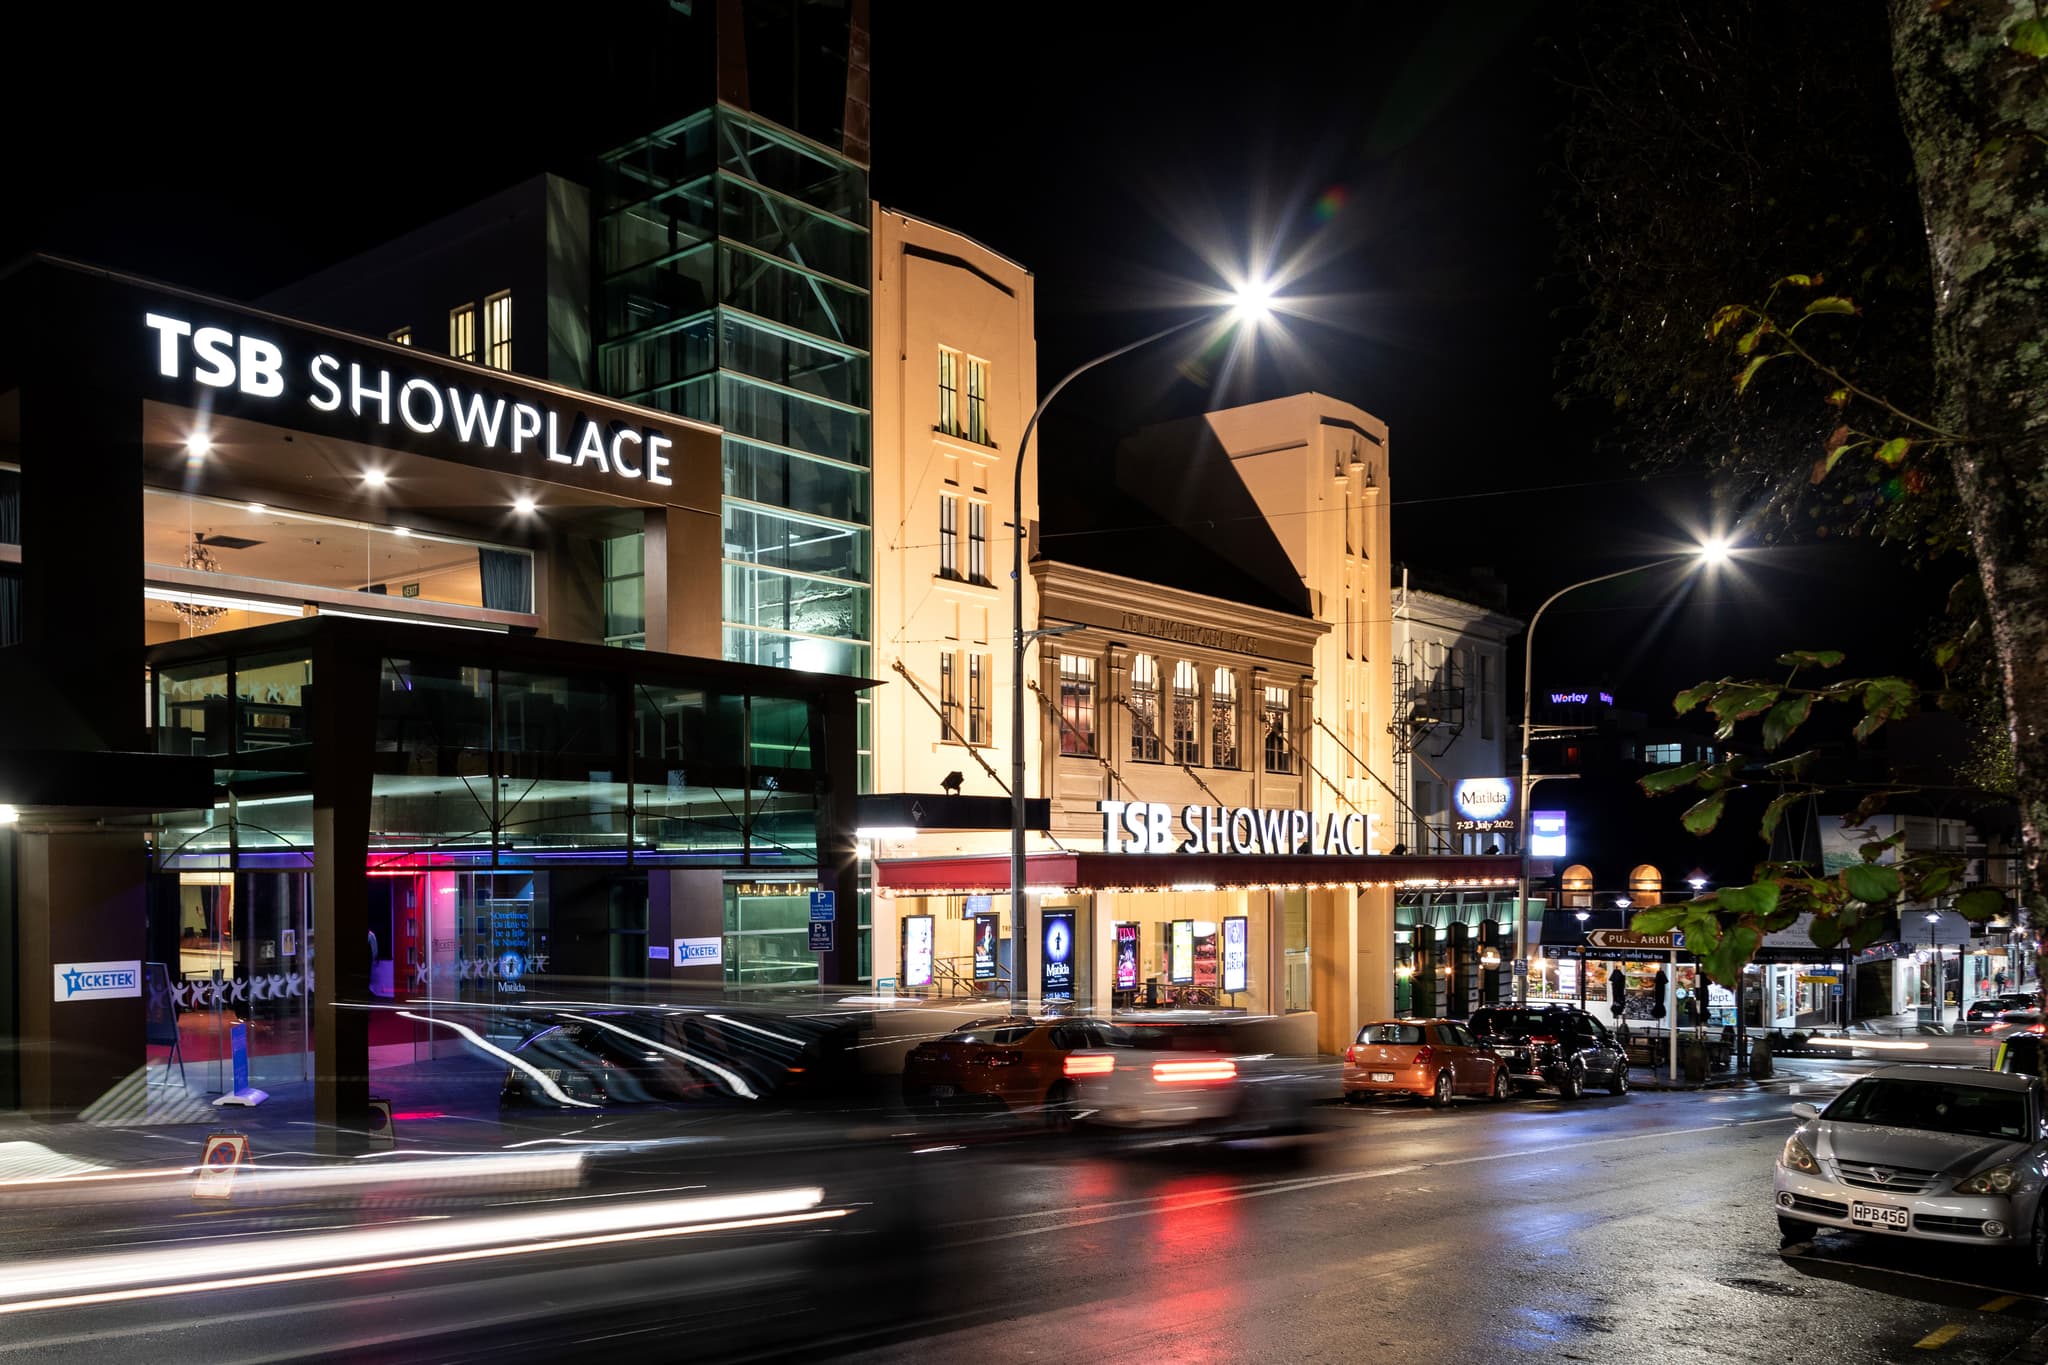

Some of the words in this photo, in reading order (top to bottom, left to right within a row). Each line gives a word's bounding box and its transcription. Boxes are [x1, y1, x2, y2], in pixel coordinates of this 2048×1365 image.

[145, 312, 284, 398] TSB
[308, 354, 673, 486] SHOWPLACE
[1551, 693, 1588, 704] Worley
[1462, 791, 1507, 805] Matilda
[1100, 800, 1171, 854] TSB
[1184, 804, 1380, 855] SHOWPLACE
[1457, 821, 1474, 830] 7-23
[1475, 820, 1493, 831] July
[818, 893, 826, 903] P
[1117, 927, 1136, 939] TINA
[1640, 935, 1669, 944] ARIKI
[681, 944, 718, 958] TICKETEK
[66, 969, 135, 989] TICKETEK
[498, 982, 526, 993] Matilda
[1854, 1206, 1906, 1225] HPB456
